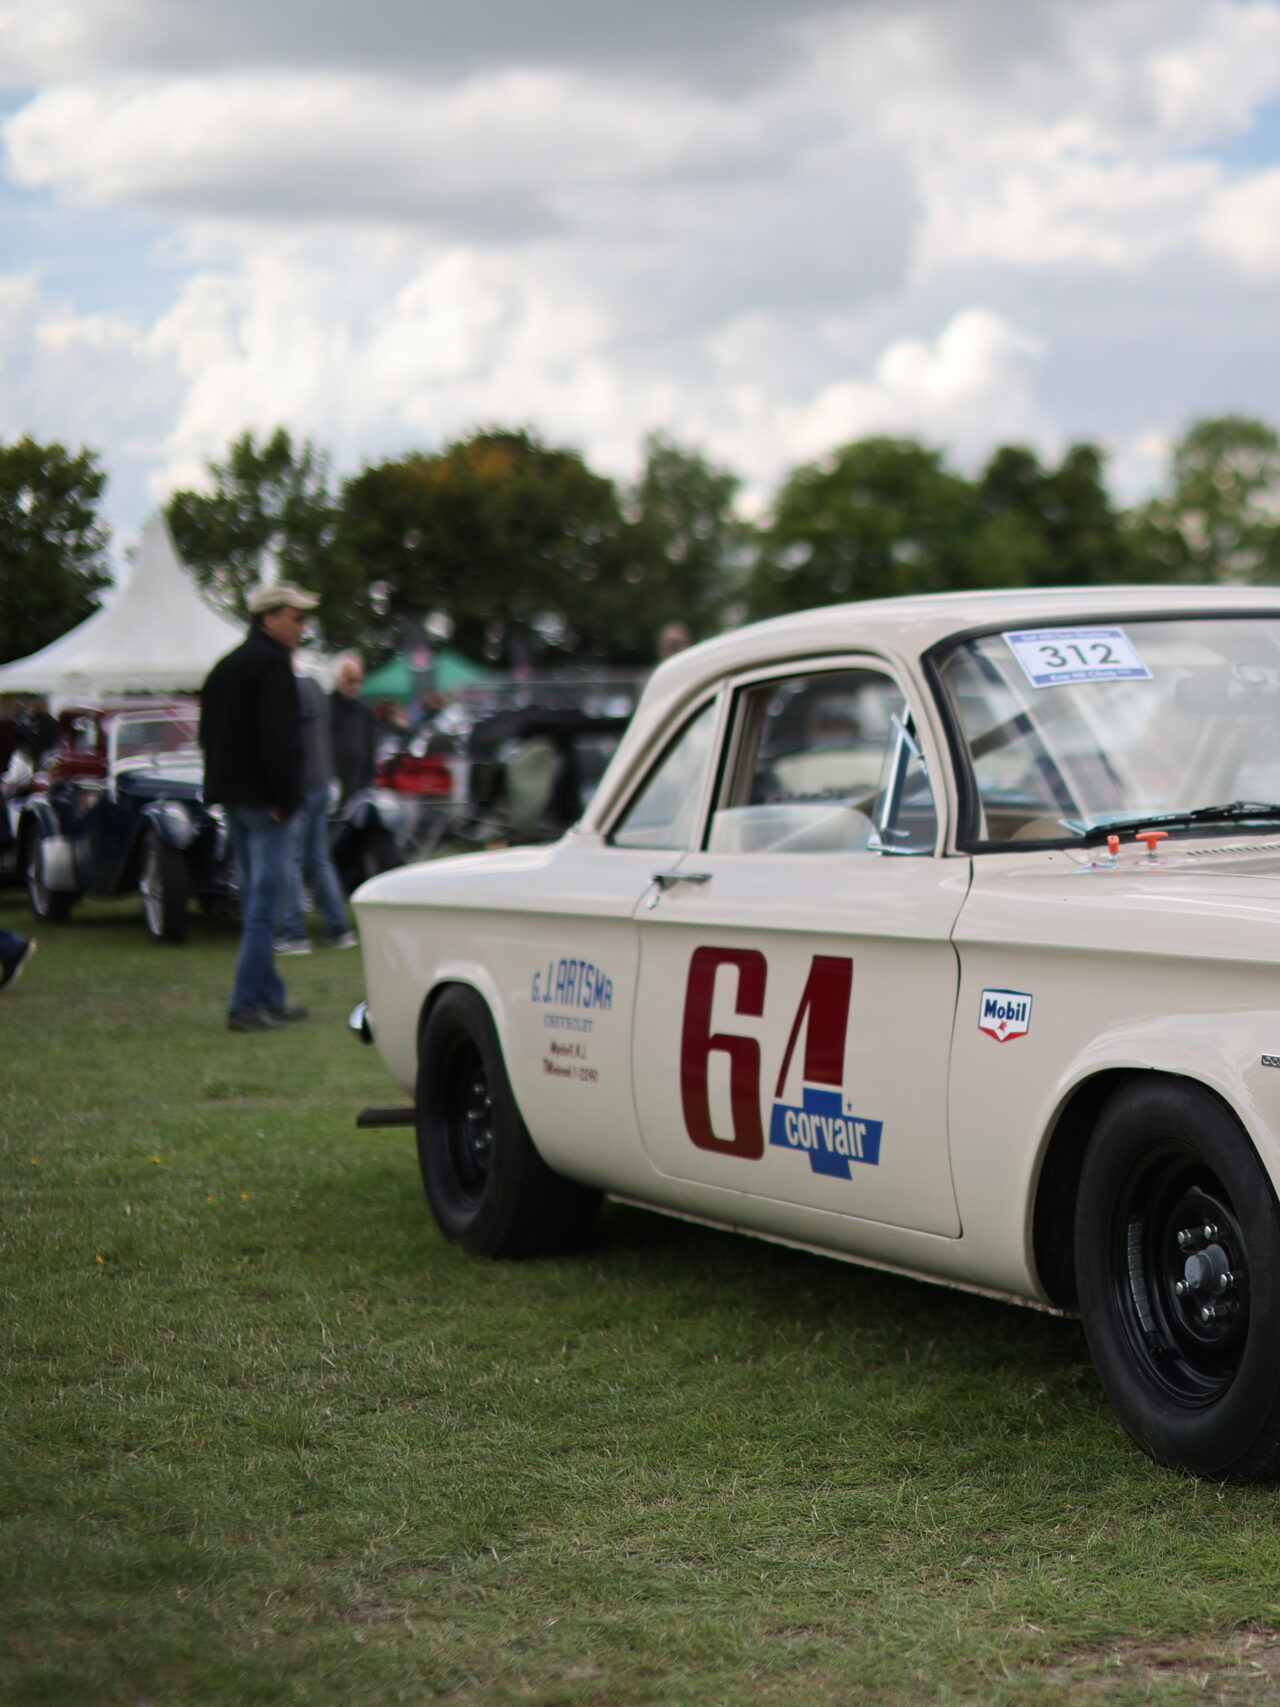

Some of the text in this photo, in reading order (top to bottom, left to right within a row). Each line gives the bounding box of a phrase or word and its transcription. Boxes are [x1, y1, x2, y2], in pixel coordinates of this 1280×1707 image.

[1038, 643, 1121, 668] 312
[984, 998, 1027, 1022] Mobil
[680, 945, 853, 1162] 64
[784, 1106, 867, 1158] corvair
